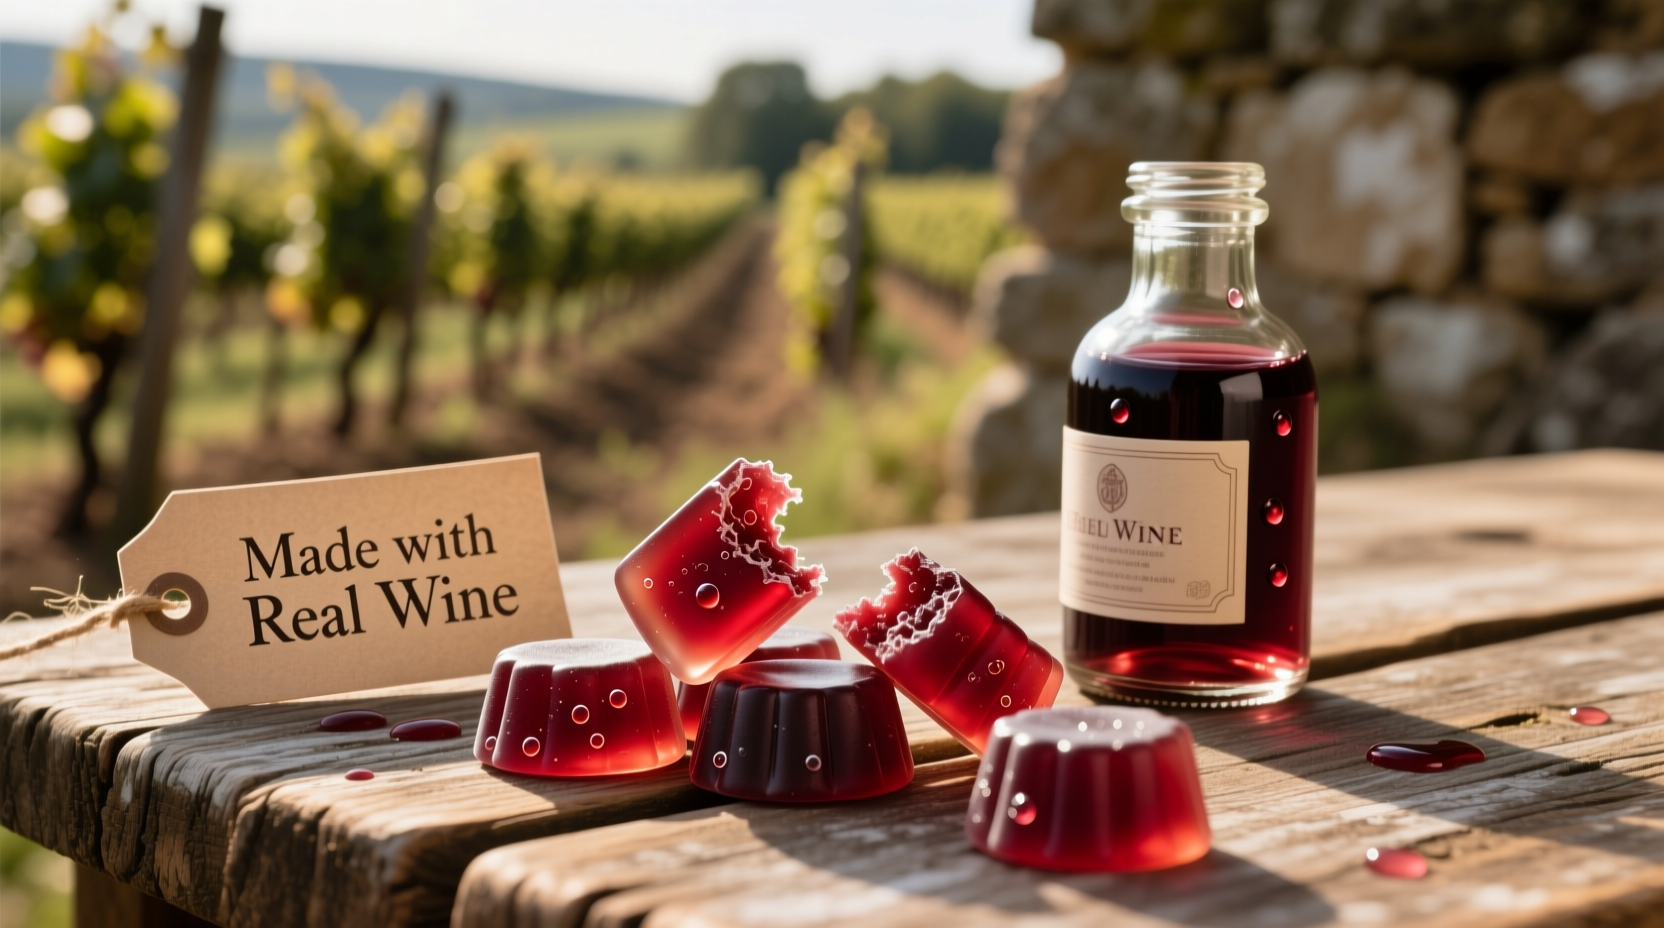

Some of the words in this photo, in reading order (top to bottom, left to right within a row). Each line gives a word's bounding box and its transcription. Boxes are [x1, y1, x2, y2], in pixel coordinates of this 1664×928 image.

[239, 526, 380, 582] Made
[392, 513, 497, 564] with
[242, 584, 367, 647] Real
[374, 575, 520, 629] Wine
